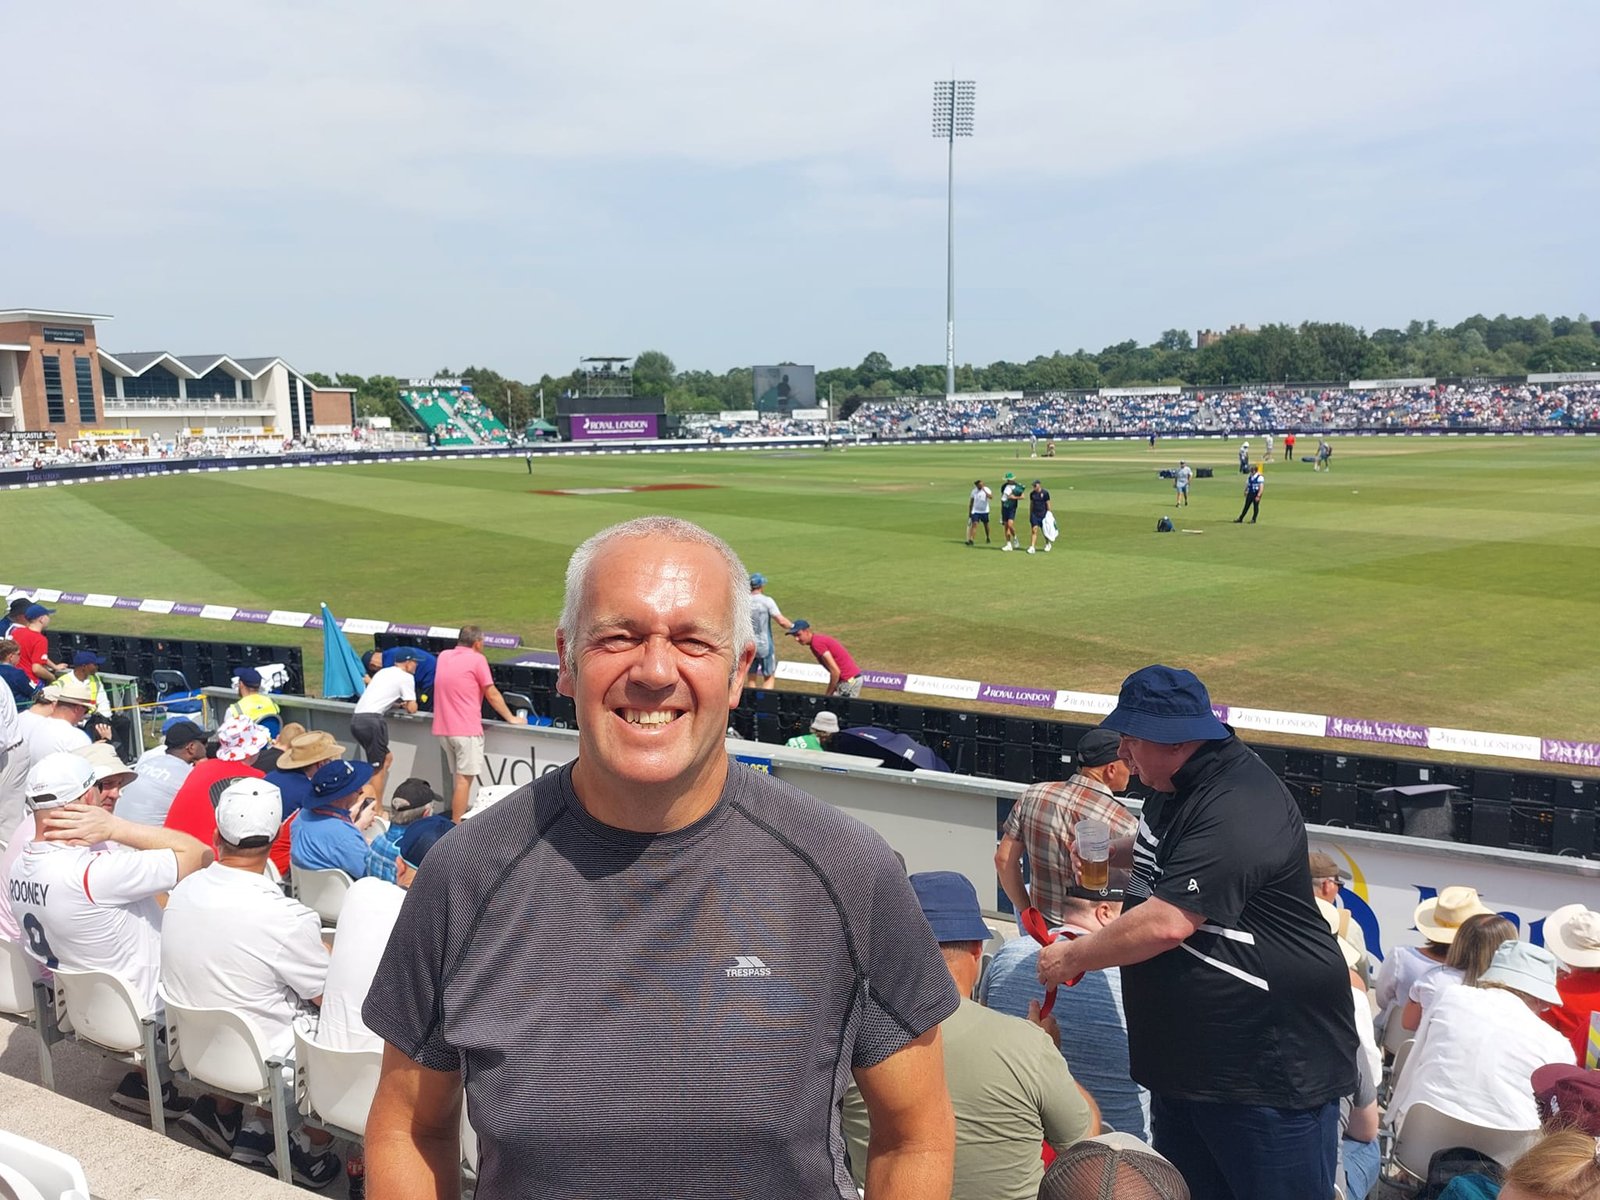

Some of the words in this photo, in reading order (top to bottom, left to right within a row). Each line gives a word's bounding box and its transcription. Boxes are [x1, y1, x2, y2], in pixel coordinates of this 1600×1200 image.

[430, 379, 462, 387] UNIQUE
[590, 421, 615, 431] ROYAL
[615, 420, 648, 430] LONDON
[12, 432, 43, 440] NEWCASTLE
[872, 676, 902, 685] LONDON
[990, 689, 1015, 699] ROYAL
[1016, 690, 1051, 702] LONDON
[1245, 714, 1271, 725] ROYAL
[1276, 717, 1319, 729] LONDON
[1343, 723, 1375, 735] ROYAL
[1377, 726, 1423, 739] LONDON
[1484, 739, 1533, 752] LONDON
[1560, 746, 1596, 759] ROYAL
[10, 878, 50, 907] ROONEY
[23, 912, 60, 970] 9
[725, 967, 771, 977] TRESPASS
